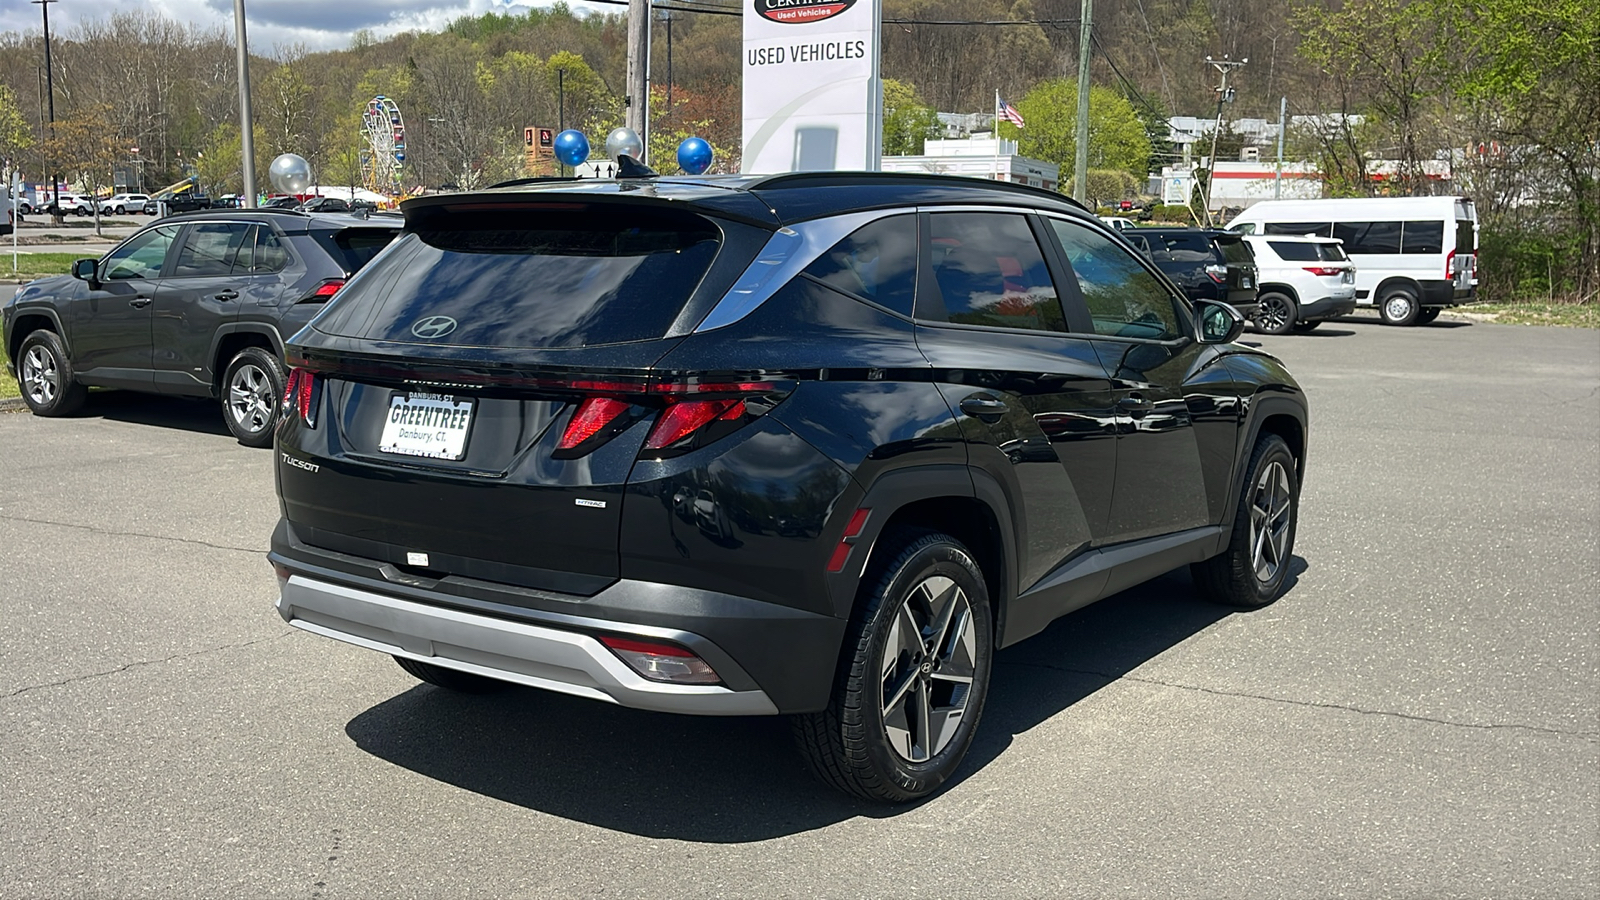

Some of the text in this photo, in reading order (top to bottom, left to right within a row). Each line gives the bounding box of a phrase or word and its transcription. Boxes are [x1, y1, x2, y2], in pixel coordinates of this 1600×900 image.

[777, 8, 831, 19] Used Vehicles
[748, 40, 865, 66] USED VEHICLES
[391, 404, 469, 430] GREENTREE
[398, 428, 433, 443] Danbury,
